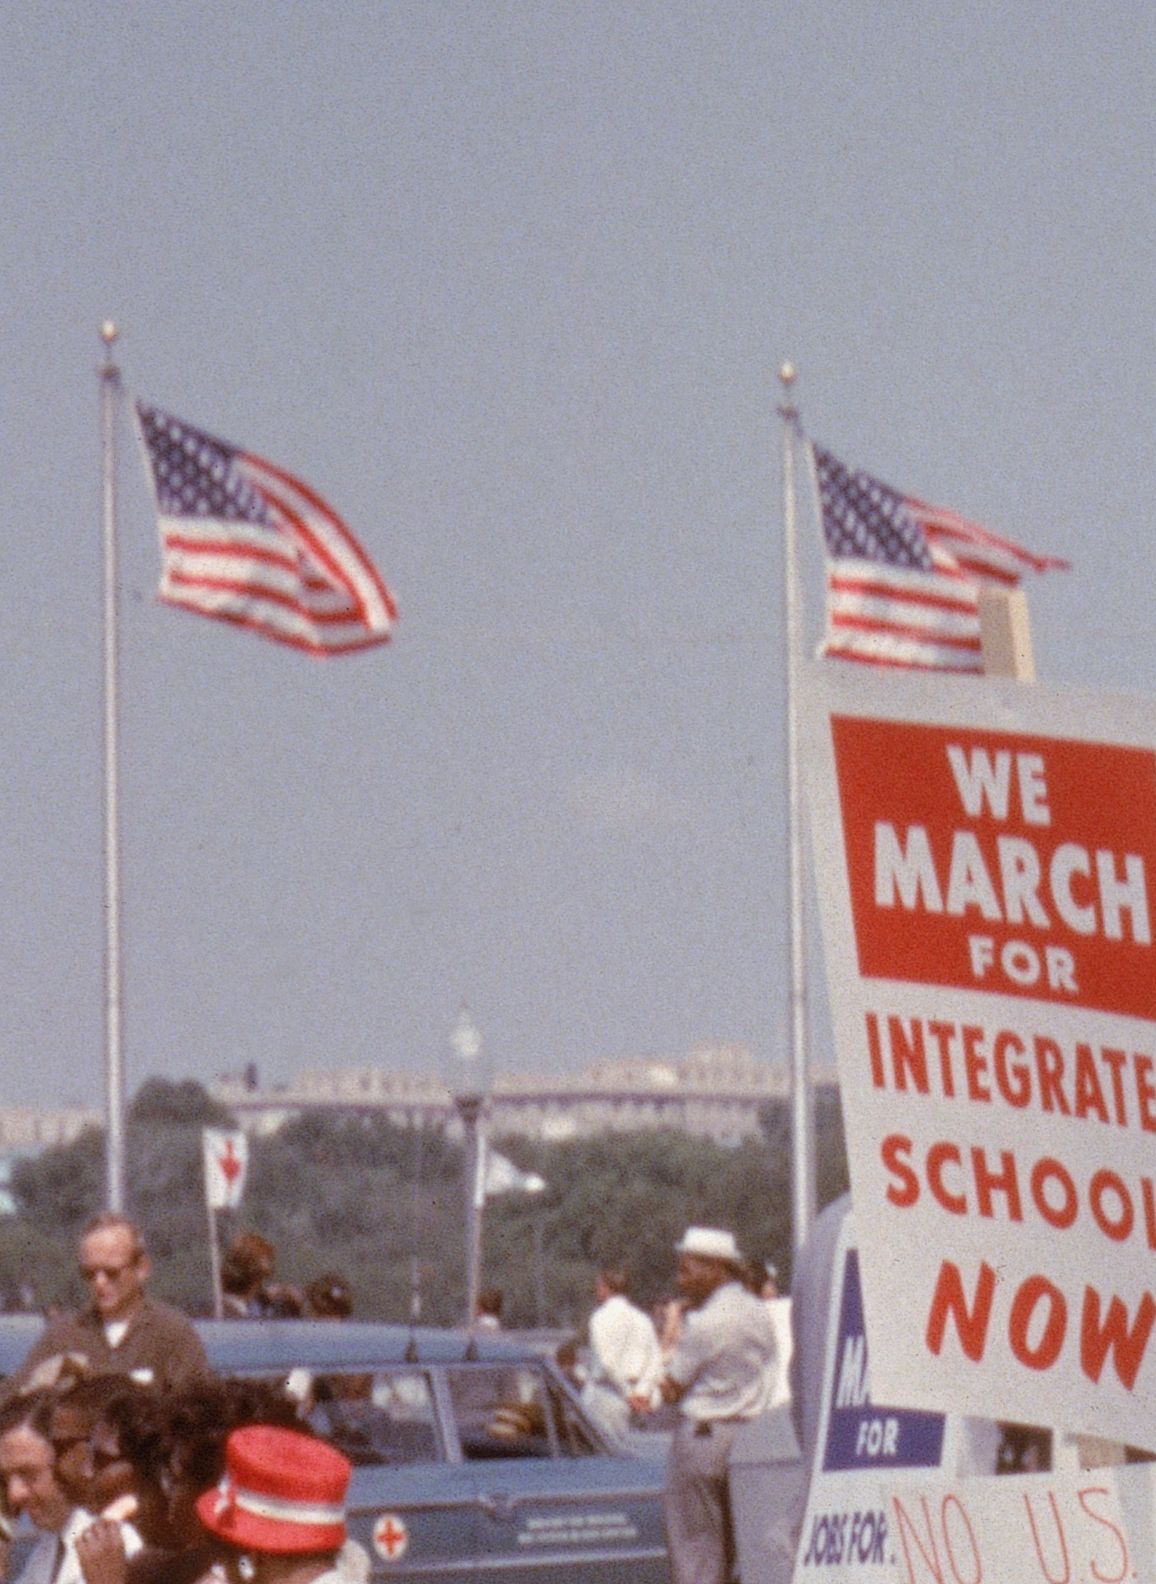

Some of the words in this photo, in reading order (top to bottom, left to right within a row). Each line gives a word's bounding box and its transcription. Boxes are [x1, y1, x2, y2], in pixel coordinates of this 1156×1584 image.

[946, 744, 1051, 827] WE
[874, 820, 1151, 946] MARCH
[968, 935, 1079, 992] FOR
[856, 1417, 899, 1457] FOR
[804, 1514, 848, 1567] JOBS
[849, 1511, 888, 1565] FOR
